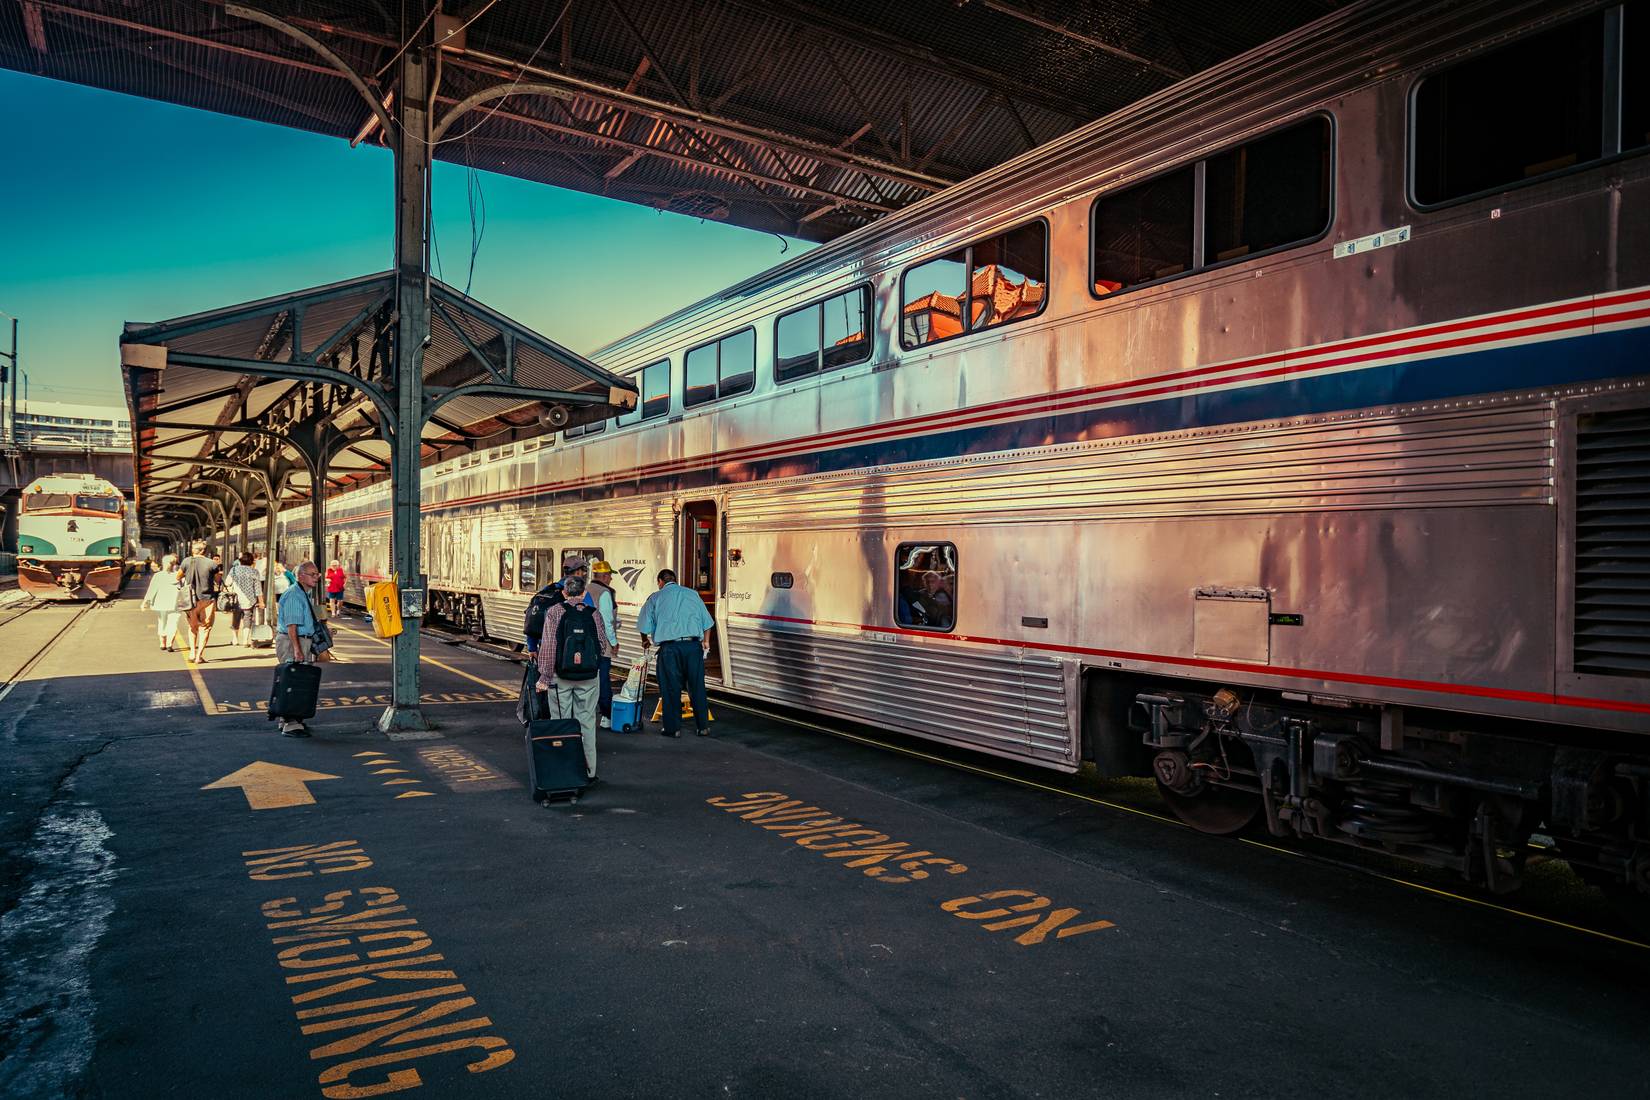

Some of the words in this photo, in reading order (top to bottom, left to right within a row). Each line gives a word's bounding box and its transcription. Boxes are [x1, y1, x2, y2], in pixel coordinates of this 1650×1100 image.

[418, 749, 497, 782] NORTH
[241, 839, 373, 880] NO
[705, 791, 968, 883] SMOKING
[940, 889, 1117, 946] NO
[261, 886, 516, 1100] SMOKING
